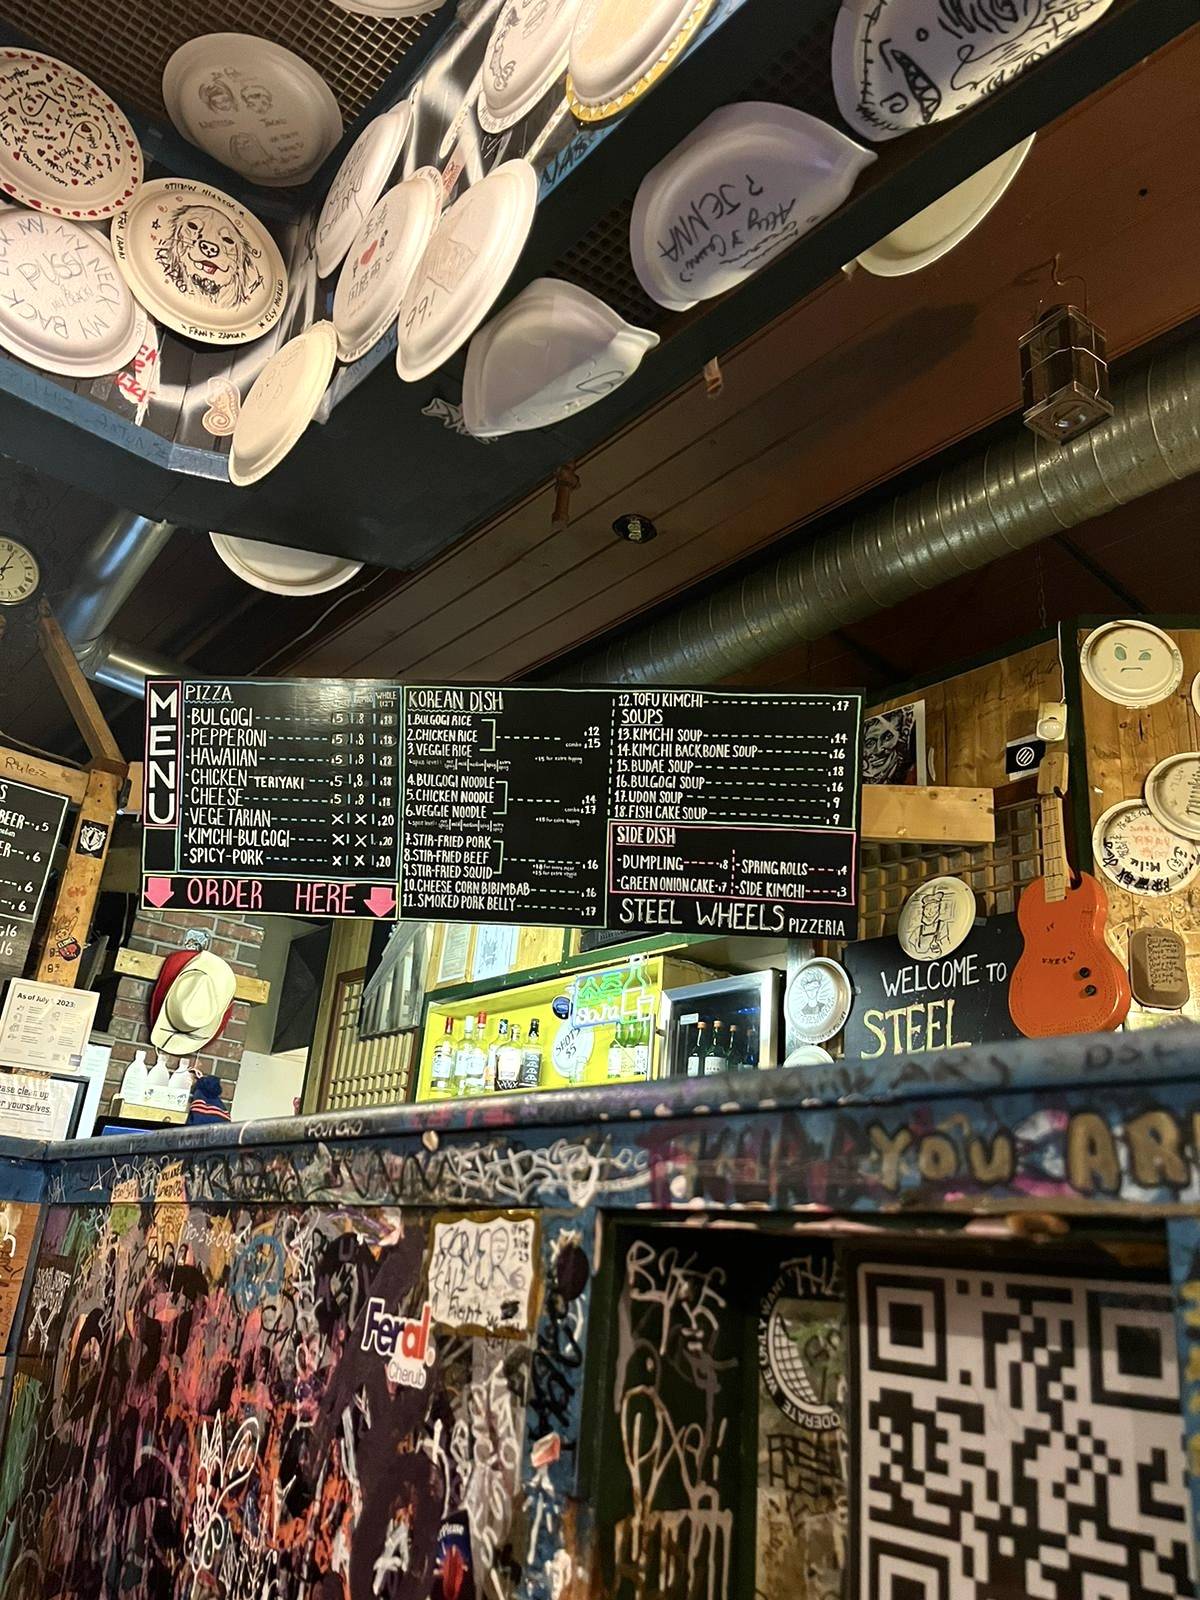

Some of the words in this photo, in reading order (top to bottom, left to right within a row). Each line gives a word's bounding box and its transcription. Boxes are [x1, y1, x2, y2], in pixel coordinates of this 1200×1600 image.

[185, 685, 232, 701] PIZZA
[376, 691, 397, 700] WHOLE
[408, 690, 464, 709] KOREAN
[469, 691, 504, 711] DISH
[662, 693, 703, 708] KIMCHI
[191, 707, 253, 727] BULGOGI
[451, 715, 472, 726] RICE
[621, 708, 664, 724] SOUPS
[190, 728, 267, 747] PEPPERONI
[457, 729, 478, 742] RICE
[677, 729, 703, 742] SOUP
[190, 748, 258, 767] HAWAIIAN
[451, 744, 472, 758] RICE
[732, 745, 758, 758] SOUP
[668, 759, 694, 774] SOUP
[461, 775, 495, 789] NOODLE
[680, 776, 705, 790] SOUP
[190, 788, 244, 807] CHEESE
[460, 790, 494, 804] NOODLE
[659, 790, 683, 804] SOUP
[452, 805, 487, 819] NOODLE
[655, 805, 680, 819] CAKE
[682, 806, 708, 820] SOUP
[466, 835, 492, 849] PORK
[617, 826, 644, 843] SIDE
[646, 827, 676, 844] DISH
[464, 851, 490, 864] BEEF
[622, 854, 684, 871] DUMPLING
[463, 865, 493, 879] SQUID
[741, 859, 779, 875] SPRING
[780, 861, 809, 876] ROLLS
[455, 881, 480, 894] CORN
[481, 881, 530, 896] BIBIMBAB
[620, 875, 658, 891] GREEN
[660, 876, 689, 892] ONION
[690, 878, 715, 894] CAKE
[739, 880, 763, 896] SIDE
[766, 882, 805, 899] KIMCHI
[187, 878, 263, 909] ORDER
[295, 883, 357, 914] HERE
[461, 895, 485, 910] PORK
[487, 896, 516, 911] BELLY
[620, 898, 683, 924] STEEL
[696, 901, 785, 933] WHEELS
[789, 917, 846, 937] PIZZERIA
[880, 954, 980, 998] WELCOME
[986, 962, 1007, 982] TO
[17, 992, 27, 1000] As
[36, 996, 49, 1005] July
[860, 998, 972, 1060] STEEL
[17, 1086, 38, 1097] clen
[40, 1091, 49, 1100] up
[867, 1119, 1014, 1192] YOU
[1067, 1105, 1200, 1196] AR
[388, 1361, 426, 1386] Cherub
